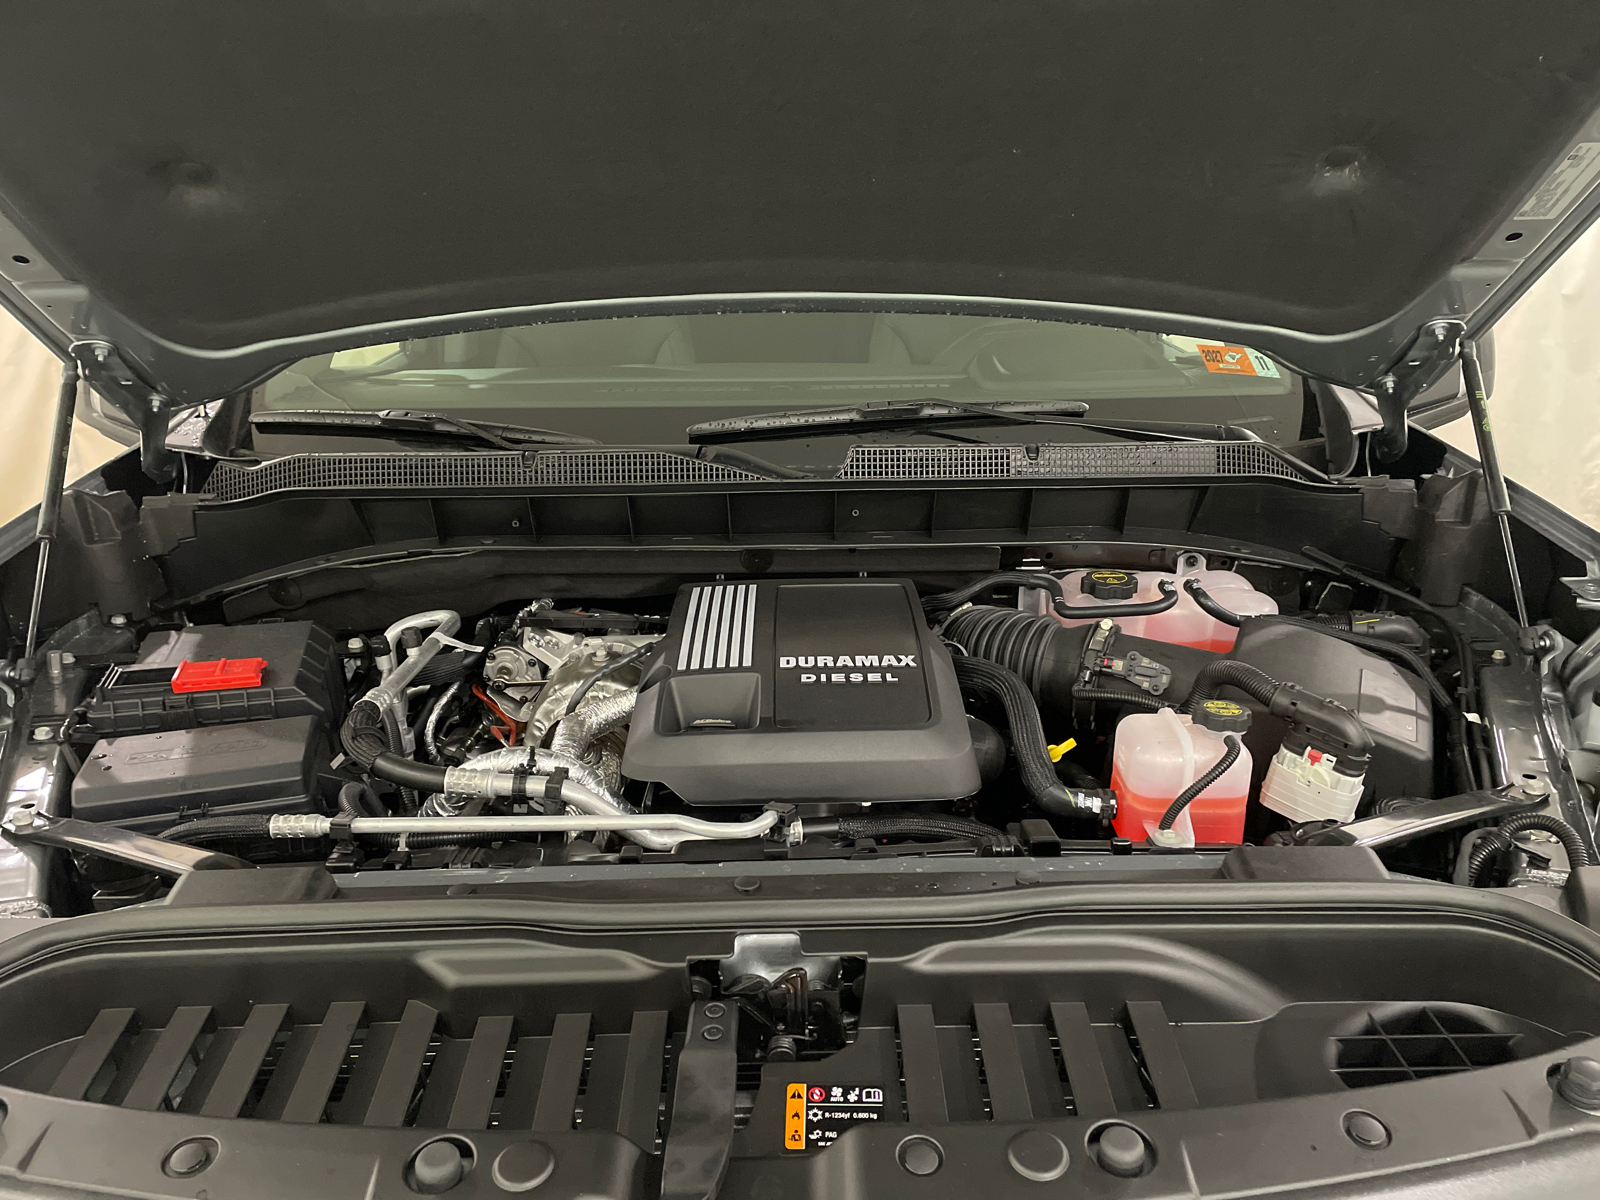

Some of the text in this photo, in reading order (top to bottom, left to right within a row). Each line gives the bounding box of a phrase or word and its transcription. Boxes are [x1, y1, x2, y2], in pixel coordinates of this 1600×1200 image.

[1201, 349, 1224, 363] 2027
[1254, 355, 1271, 371] 11
[779, 655, 917, 668] DURAMAX
[801, 673, 899, 683] DIESEL
